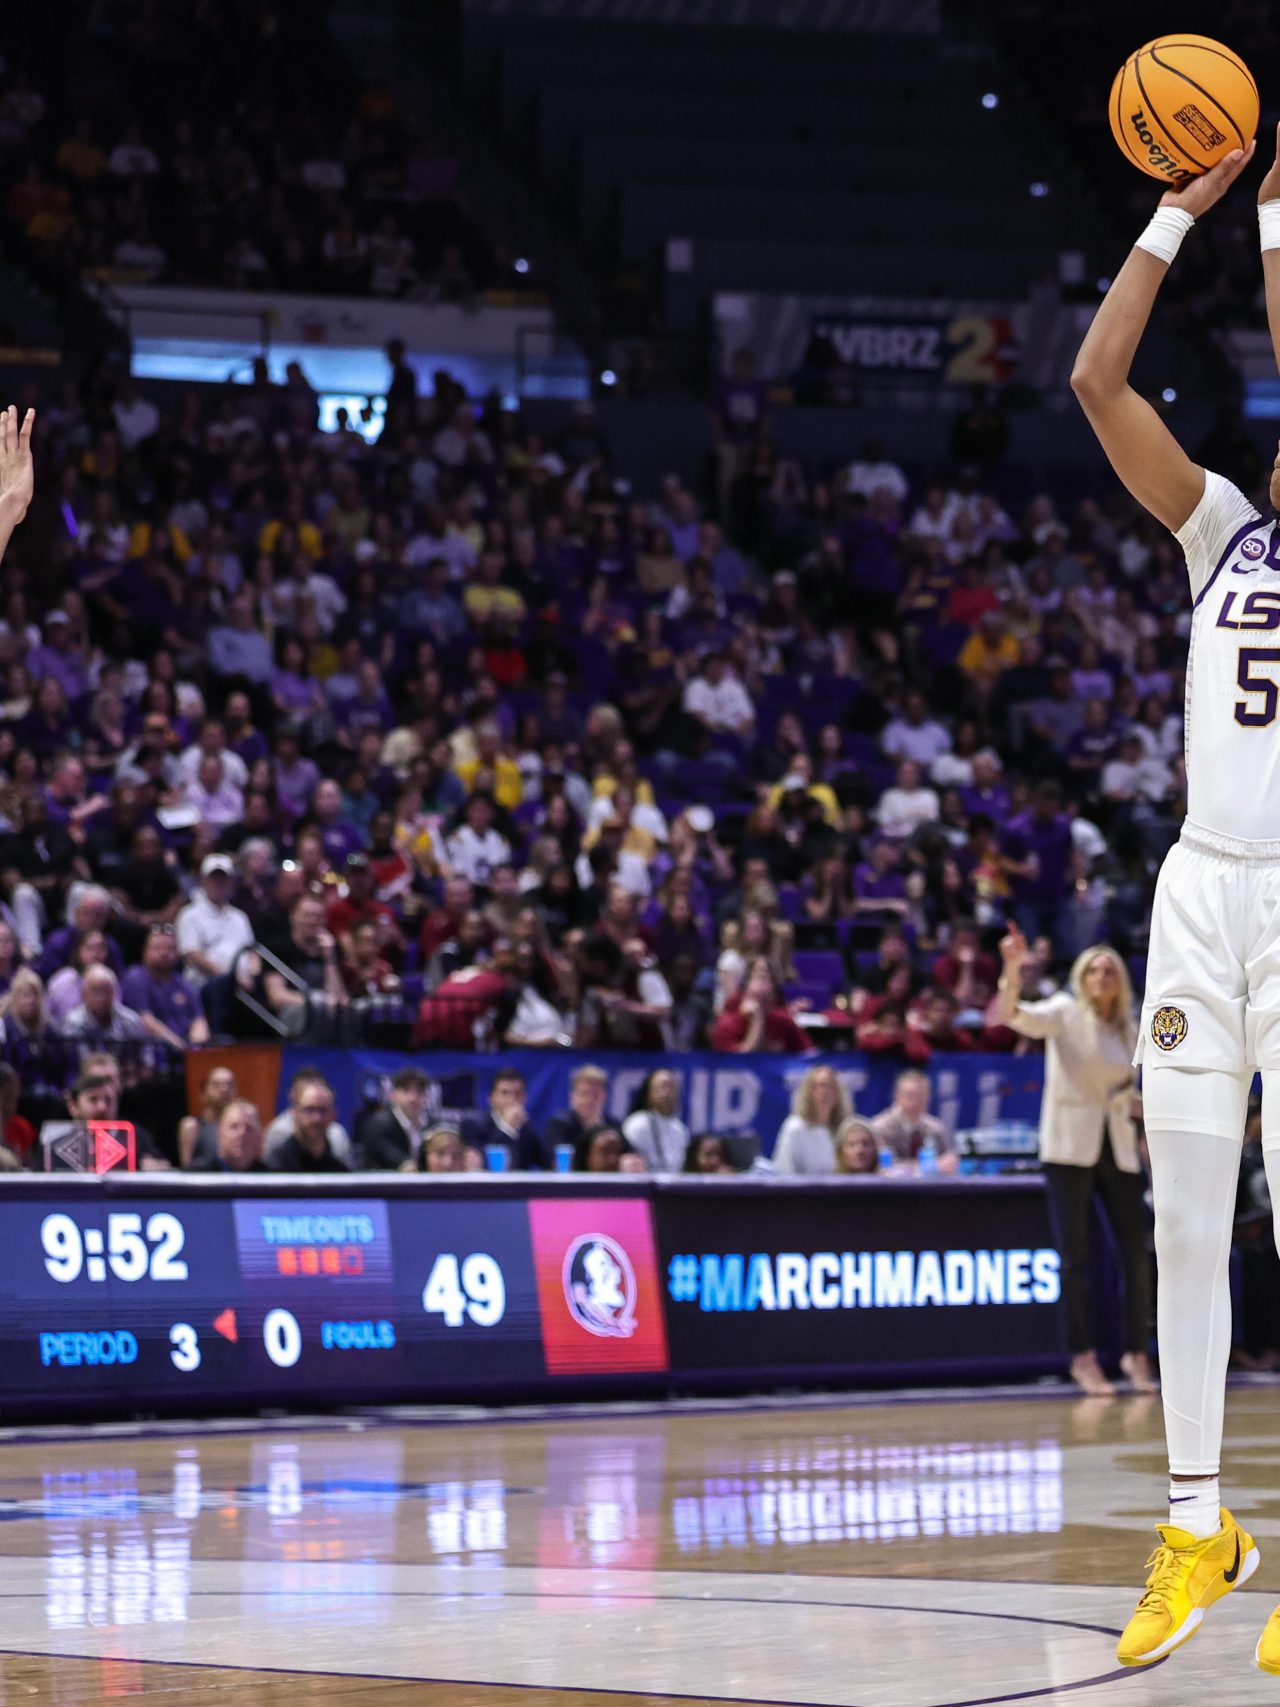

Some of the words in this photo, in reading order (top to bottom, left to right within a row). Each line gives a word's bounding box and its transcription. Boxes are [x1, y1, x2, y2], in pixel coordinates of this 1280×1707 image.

[41, 1212, 189, 1282] 9:52
[260, 1214, 374, 1244] TIMEOUTS
[423, 1253, 506, 1327] 49
[669, 1248, 1062, 1312] #MARCHMADNES
[39, 1330, 138, 1366] PERIOD
[168, 1322, 201, 1372] 3
[263, 1308, 302, 1368] 0
[320, 1319, 396, 1349] FOULS
